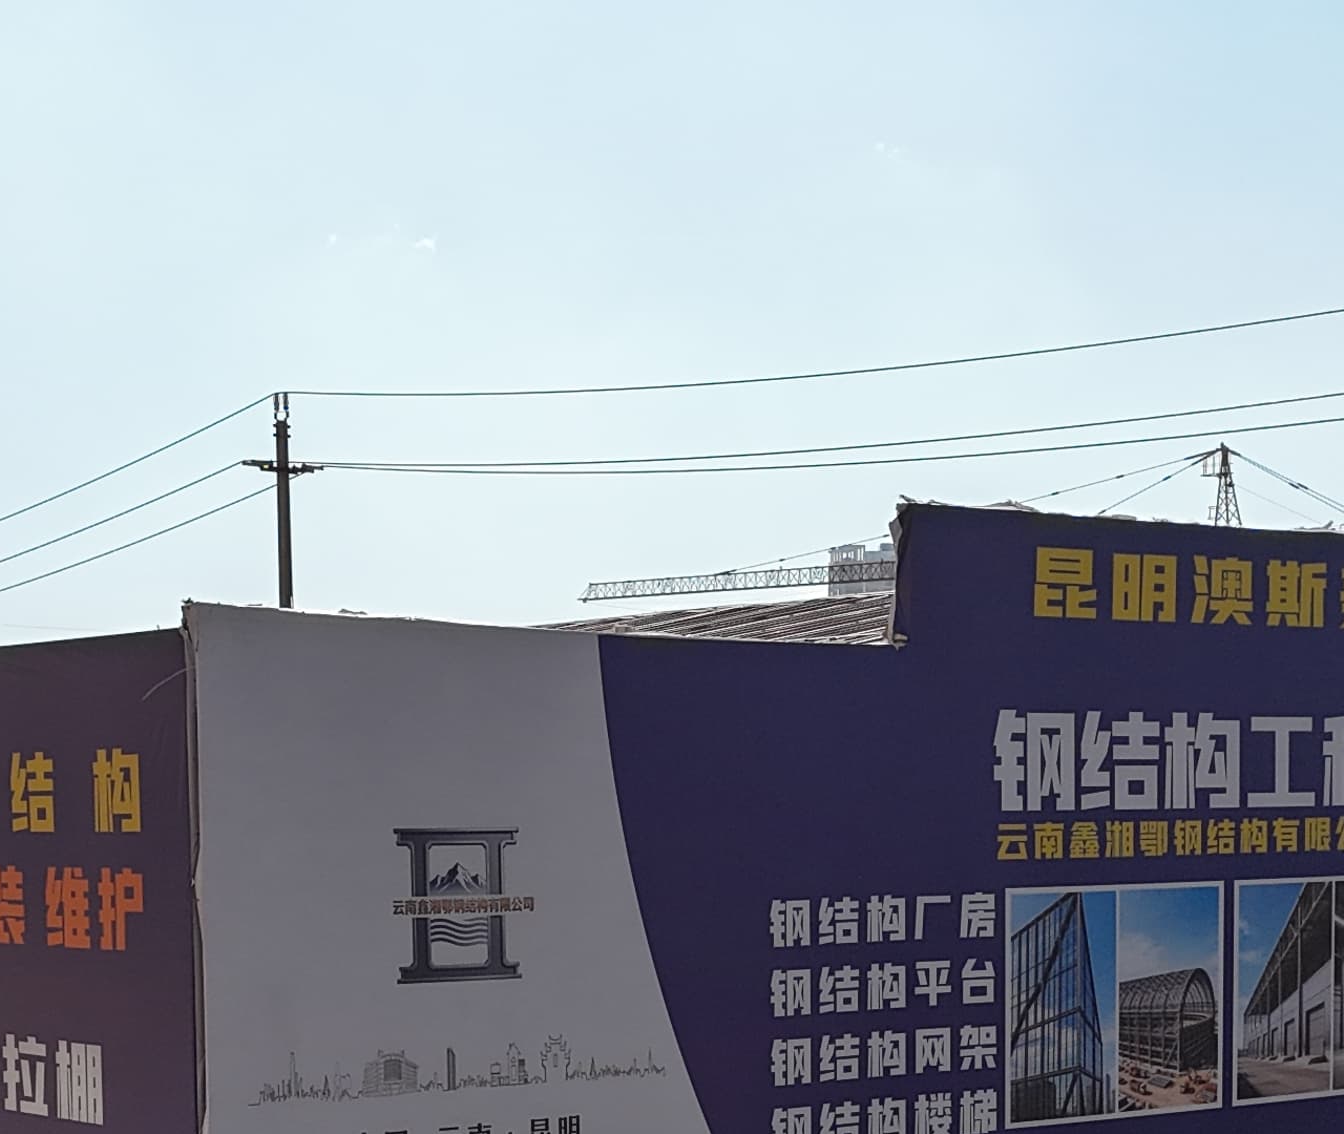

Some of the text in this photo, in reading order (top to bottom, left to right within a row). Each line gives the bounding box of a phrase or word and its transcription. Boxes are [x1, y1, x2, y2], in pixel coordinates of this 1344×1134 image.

[769, 892, 997, 948] 钢结构厂房
[770, 958, 997, 1018] 钢结构平台
[770, 1025, 998, 1087] 钢结构网架
